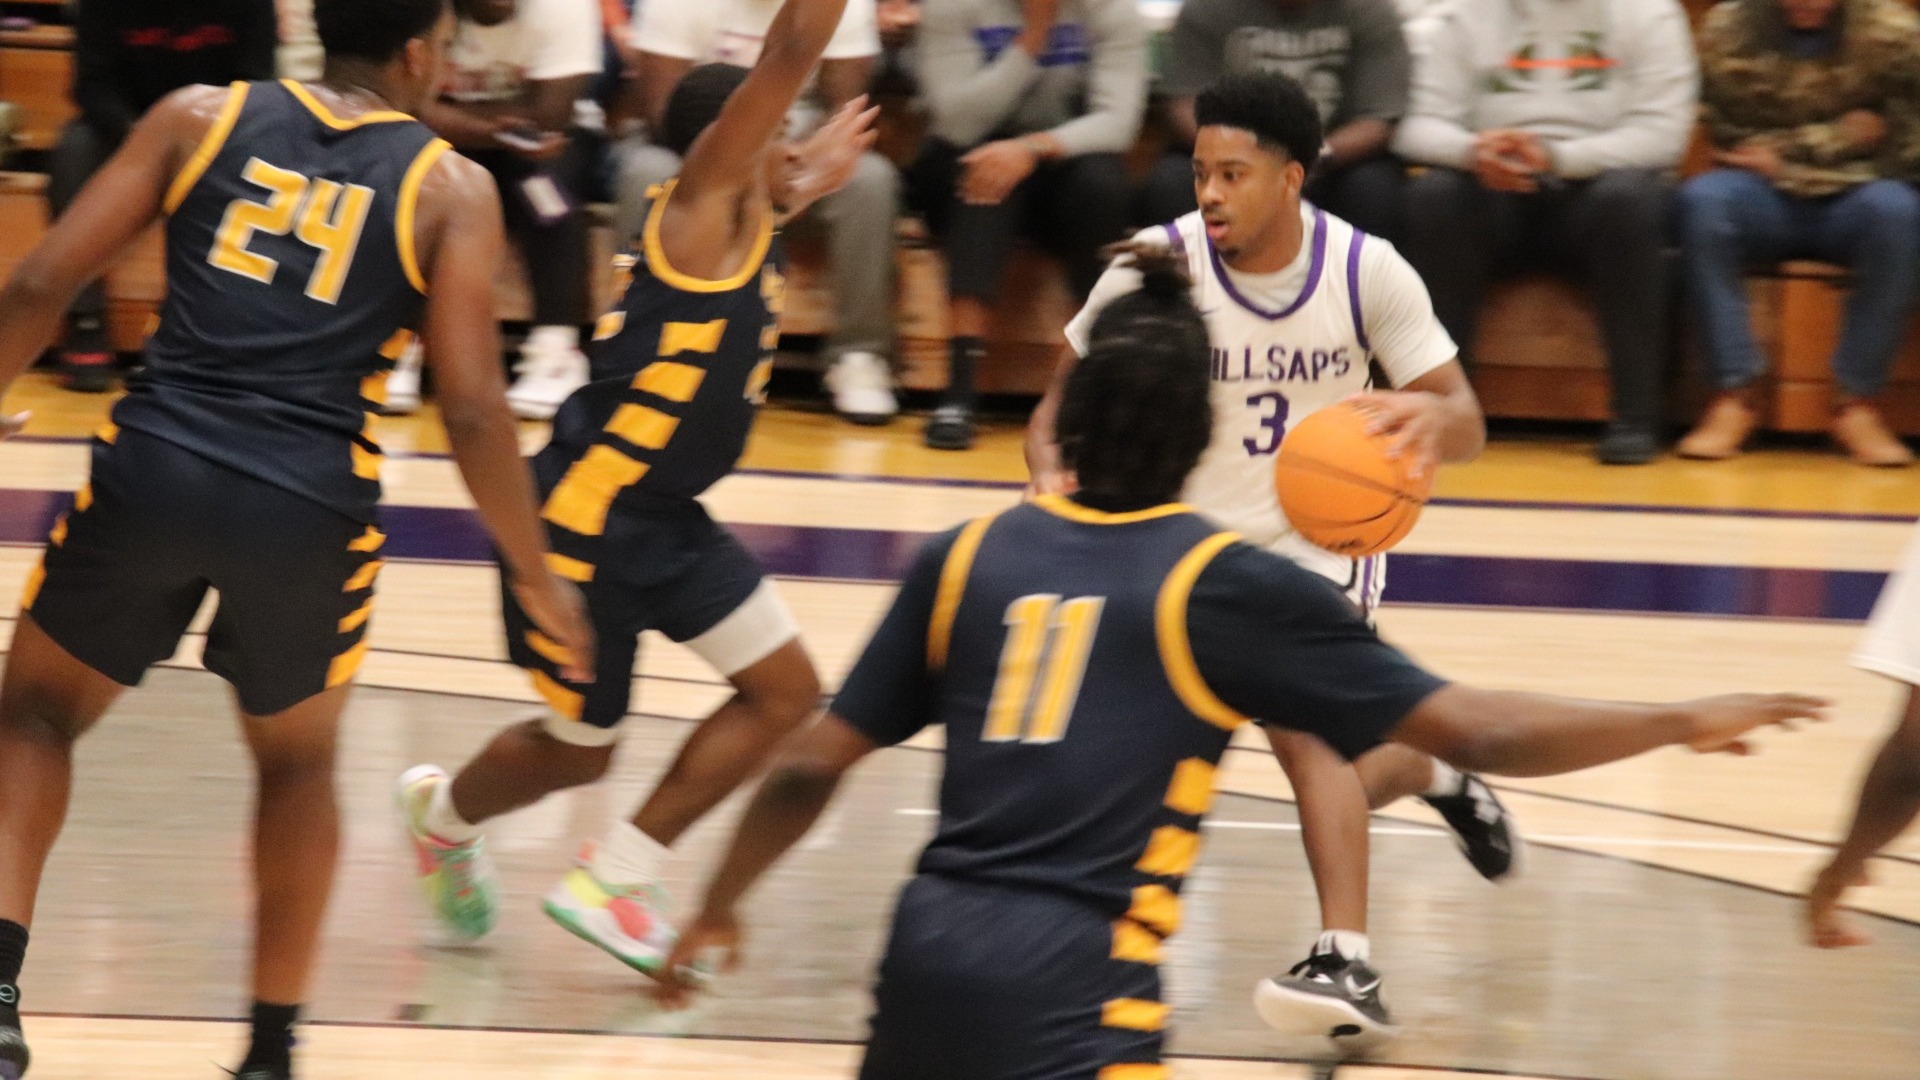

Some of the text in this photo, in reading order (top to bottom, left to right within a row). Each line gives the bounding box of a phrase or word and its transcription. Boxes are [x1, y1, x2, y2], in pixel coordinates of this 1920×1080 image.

[206, 156, 376, 306] 24
[1208, 345, 1350, 383] ILLSAPS
[1242, 391, 1290, 456] 3
[980, 593, 1108, 745] 11
